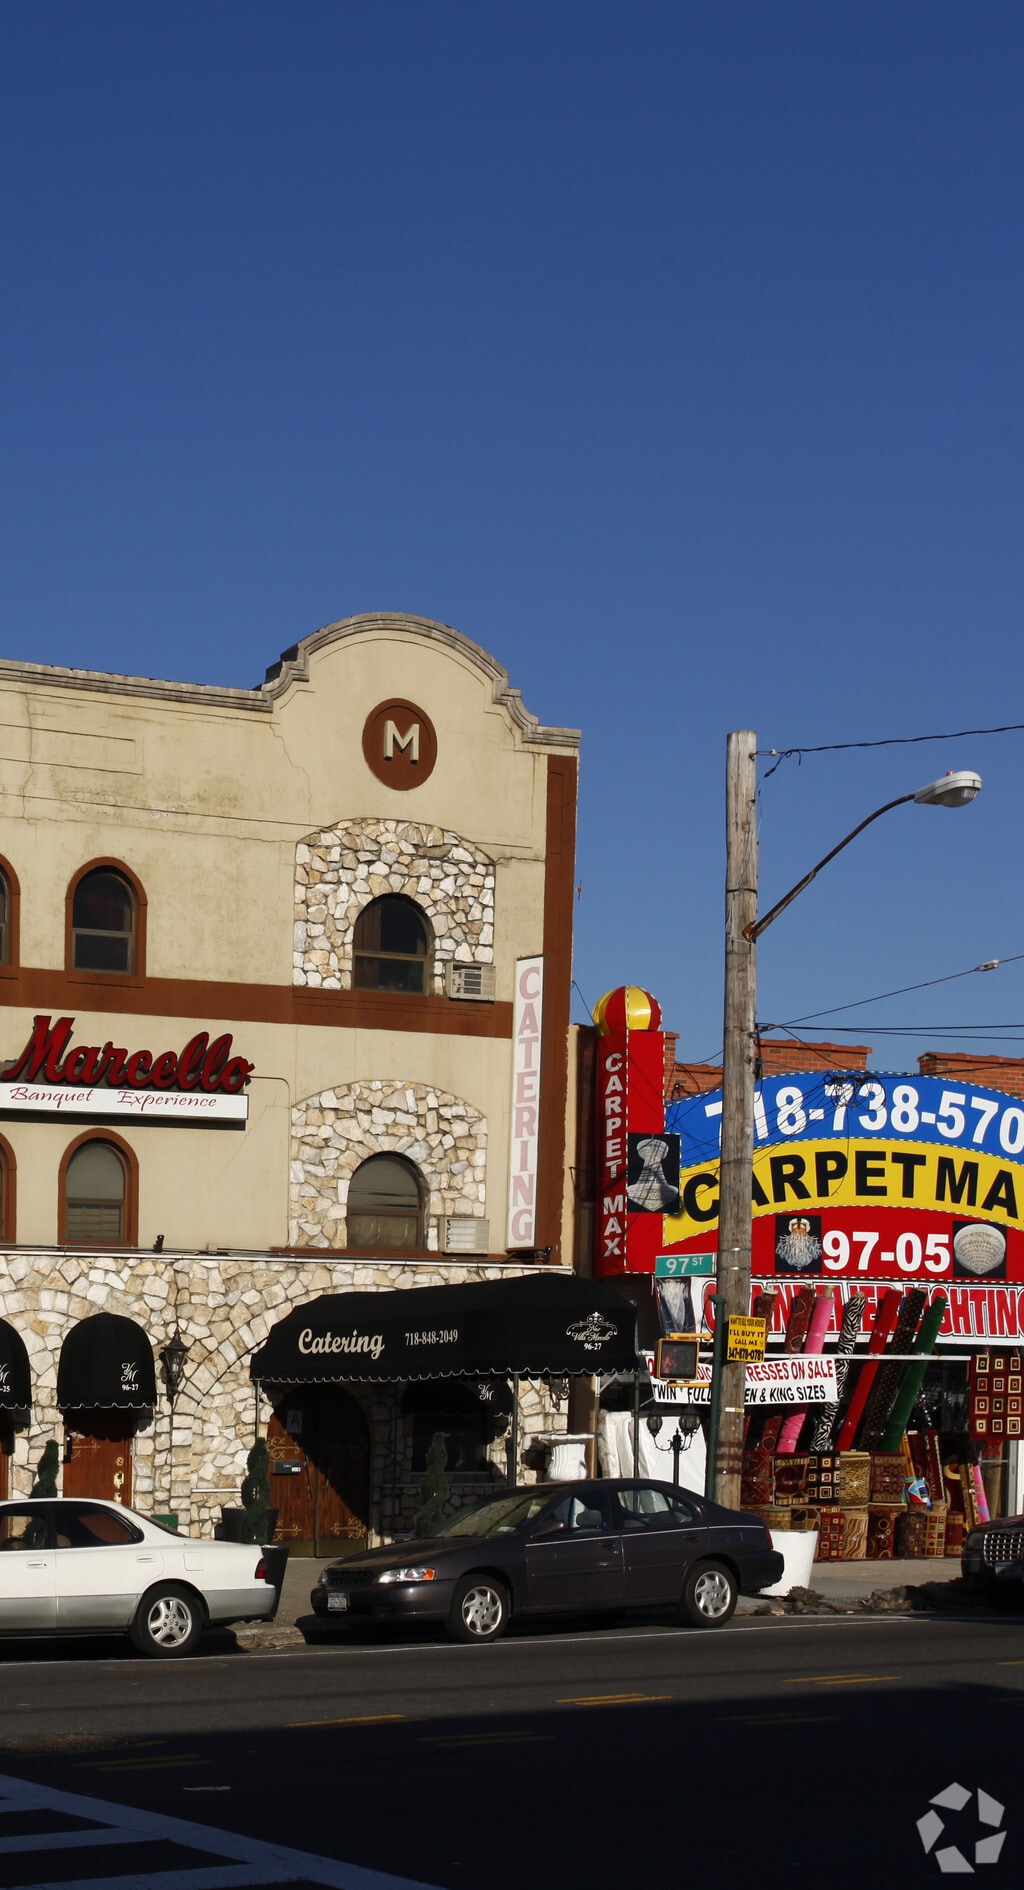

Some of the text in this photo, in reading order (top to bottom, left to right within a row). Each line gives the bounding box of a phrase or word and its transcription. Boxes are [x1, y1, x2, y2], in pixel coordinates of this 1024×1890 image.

[383, 719, 420, 765] M
[1, 1014, 255, 1094] Marcello
[9, 1086, 95, 1109] Banquet
[117, 1090, 217, 1112] Experience
[510, 965, 541, 1243] CATERING
[602, 1052, 625, 1258] CARPET MAX
[935, 1155, 1024, 1221] MA
[666, 1256, 704, 1274] 97 ST
[822, 1231, 951, 1273] 97-05
[298, 1328, 459, 1360] Catering 718-848-2049
[583, 1342, 602, 1351] 96-27
[734, 1338, 758, 1347] CALL ME
[792, 1360, 805, 1379] ON
[807, 1359, 834, 1378] SALE
[121, 1383, 140, 1392] 96-27
[760, 1387, 766, 1401] &
[769, 1386, 794, 1402] KING
[797, 1384, 826, 1401] SIZES
